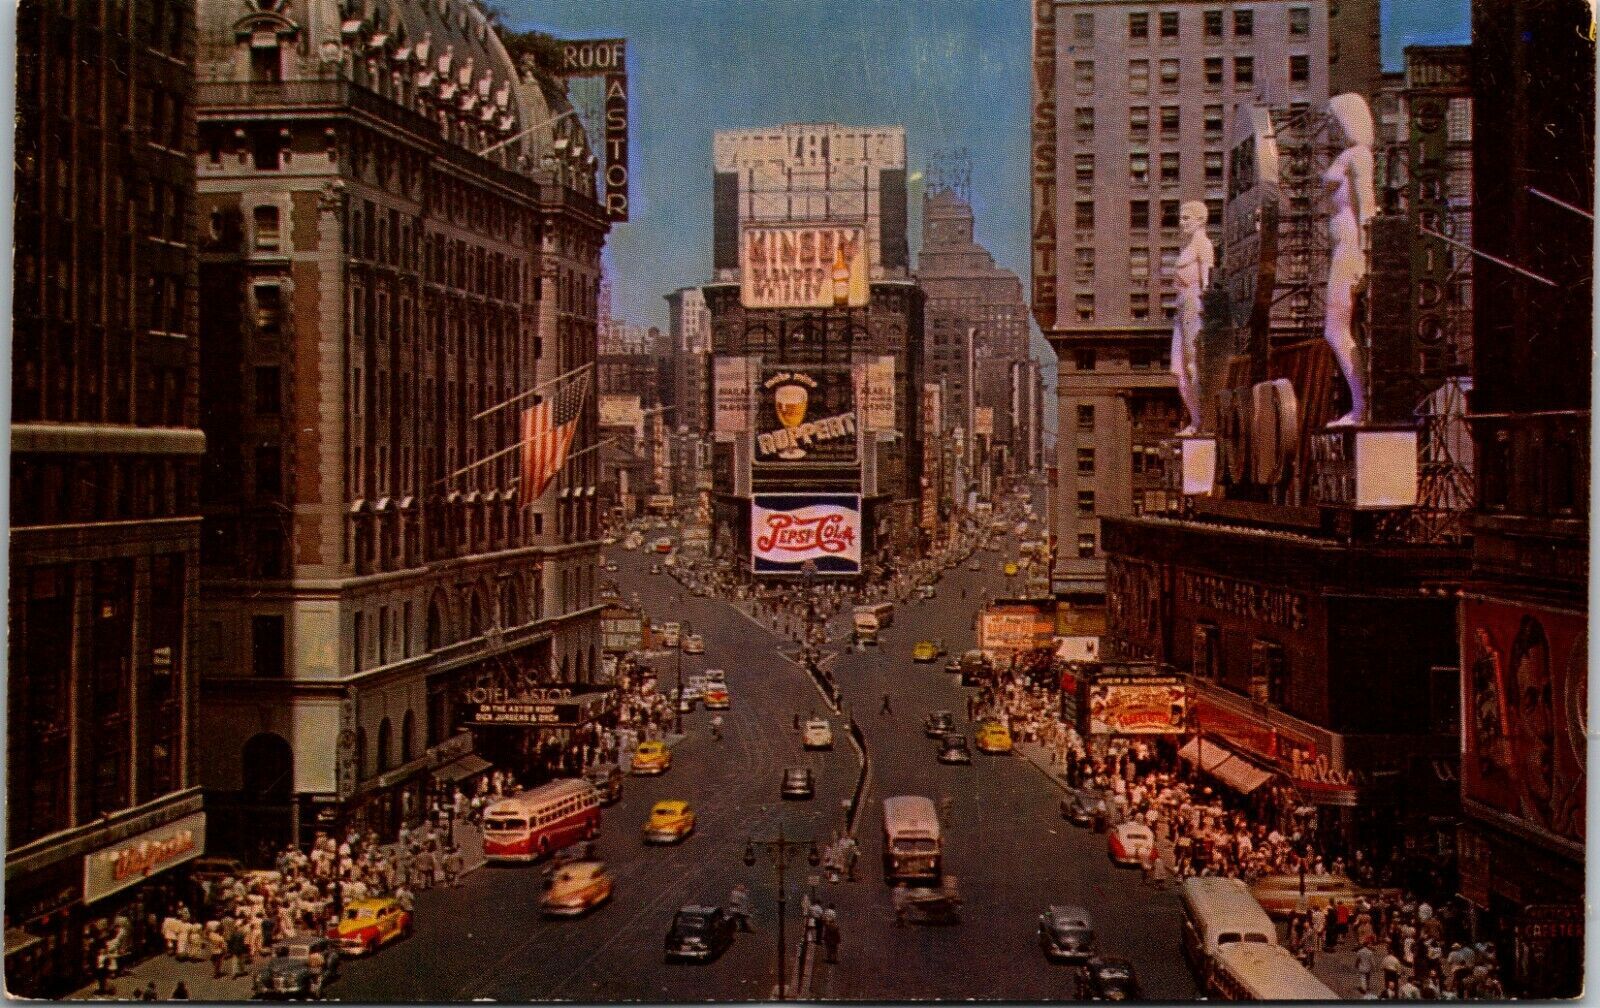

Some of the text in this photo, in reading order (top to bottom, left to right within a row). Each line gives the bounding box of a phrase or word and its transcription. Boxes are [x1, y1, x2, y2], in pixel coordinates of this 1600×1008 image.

[563, 43, 624, 68] ROOF
[605, 79, 628, 215] ASTOR
[748, 229, 860, 263] KINSEY
[757, 411, 856, 455] RUPPERT
